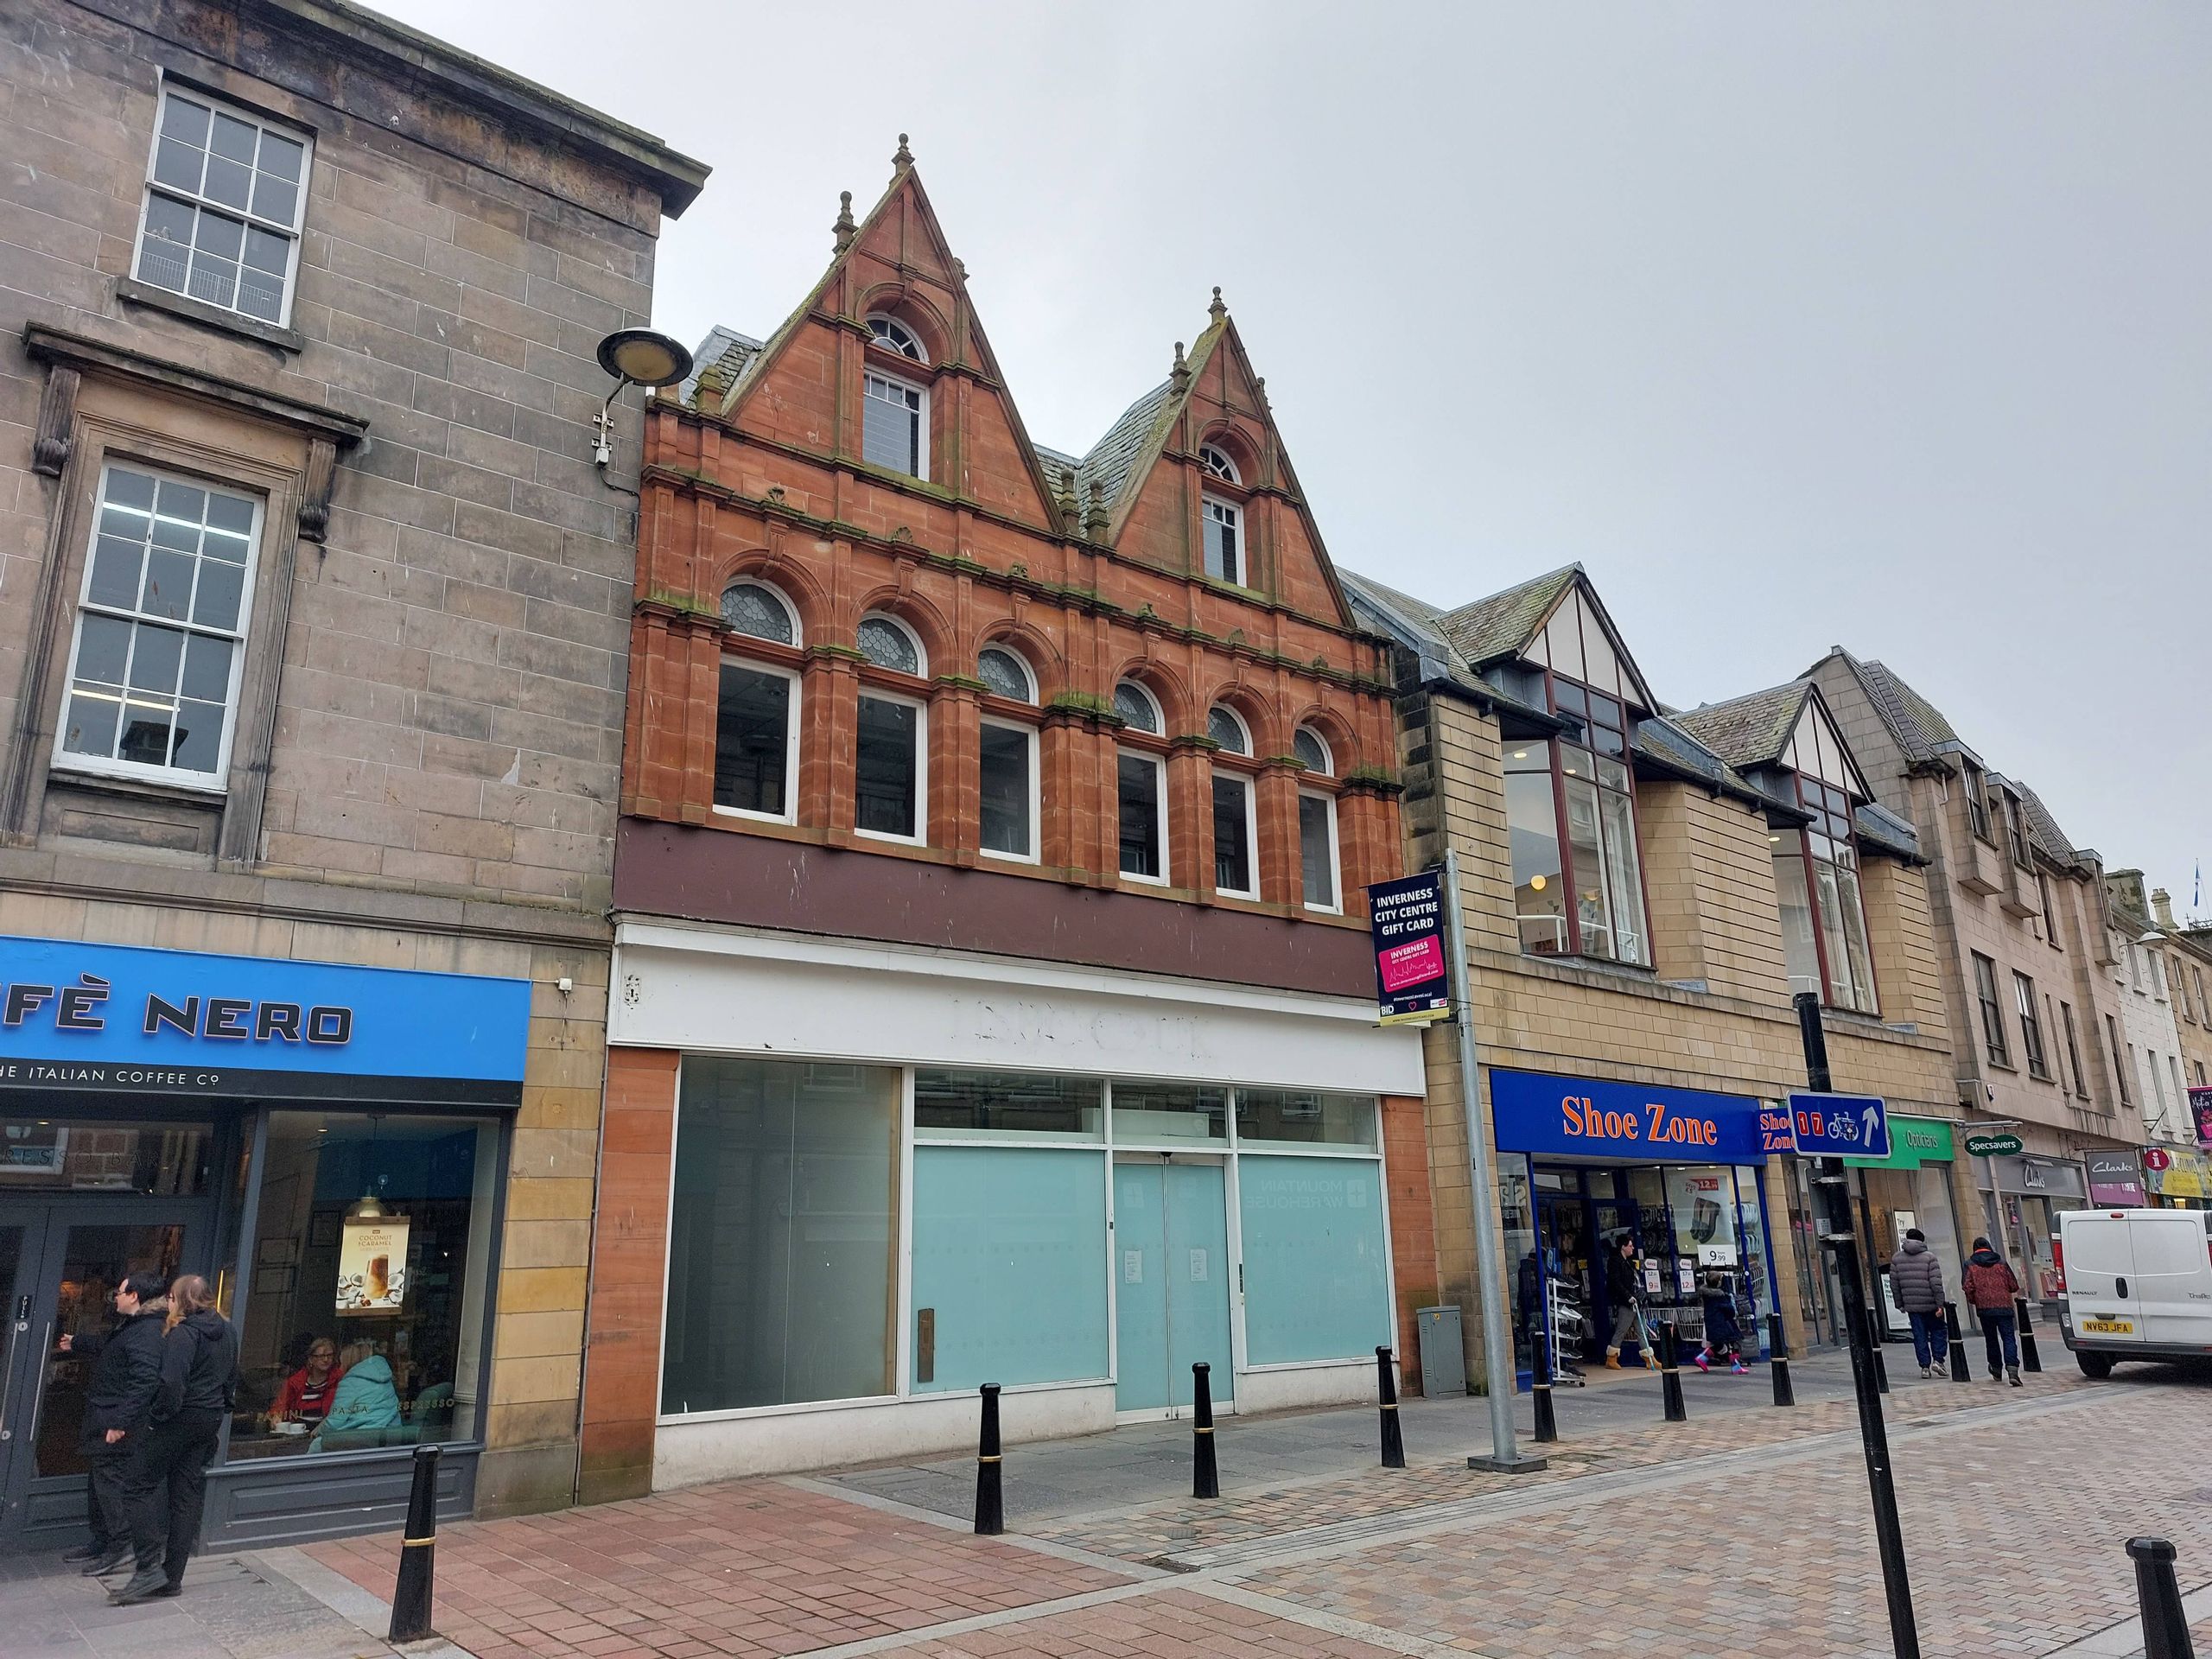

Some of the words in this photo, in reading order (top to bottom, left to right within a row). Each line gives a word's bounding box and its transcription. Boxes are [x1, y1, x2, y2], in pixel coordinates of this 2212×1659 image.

[1377, 887, 1433, 908] INVERNESS
[1375, 909, 1397, 923] CITY
[1400, 901, 1439, 918] CENTRE
[1382, 923, 1404, 936] GIFT
[1407, 917, 1434, 931] CARD
[1390, 941, 1428, 959] INVERNESS
[0, 972, 111, 1030] FÈ
[143, 992, 353, 1045] NERO
[29, 1067, 105, 1082] ITALIAN
[116, 1071, 187, 1084] COFFEE
[1561, 1096, 1639, 1140] Shoe
[1645, 1103, 1718, 1146] Zone
[1907, 1129, 1938, 1150] Opticians
[1969, 1140, 2017, 1152] Specsavers
[2092, 1161, 2134, 1173] Clarks
[2086, 1323, 2109, 1332] NV63
[2111, 1324, 2129, 1332] JFA
